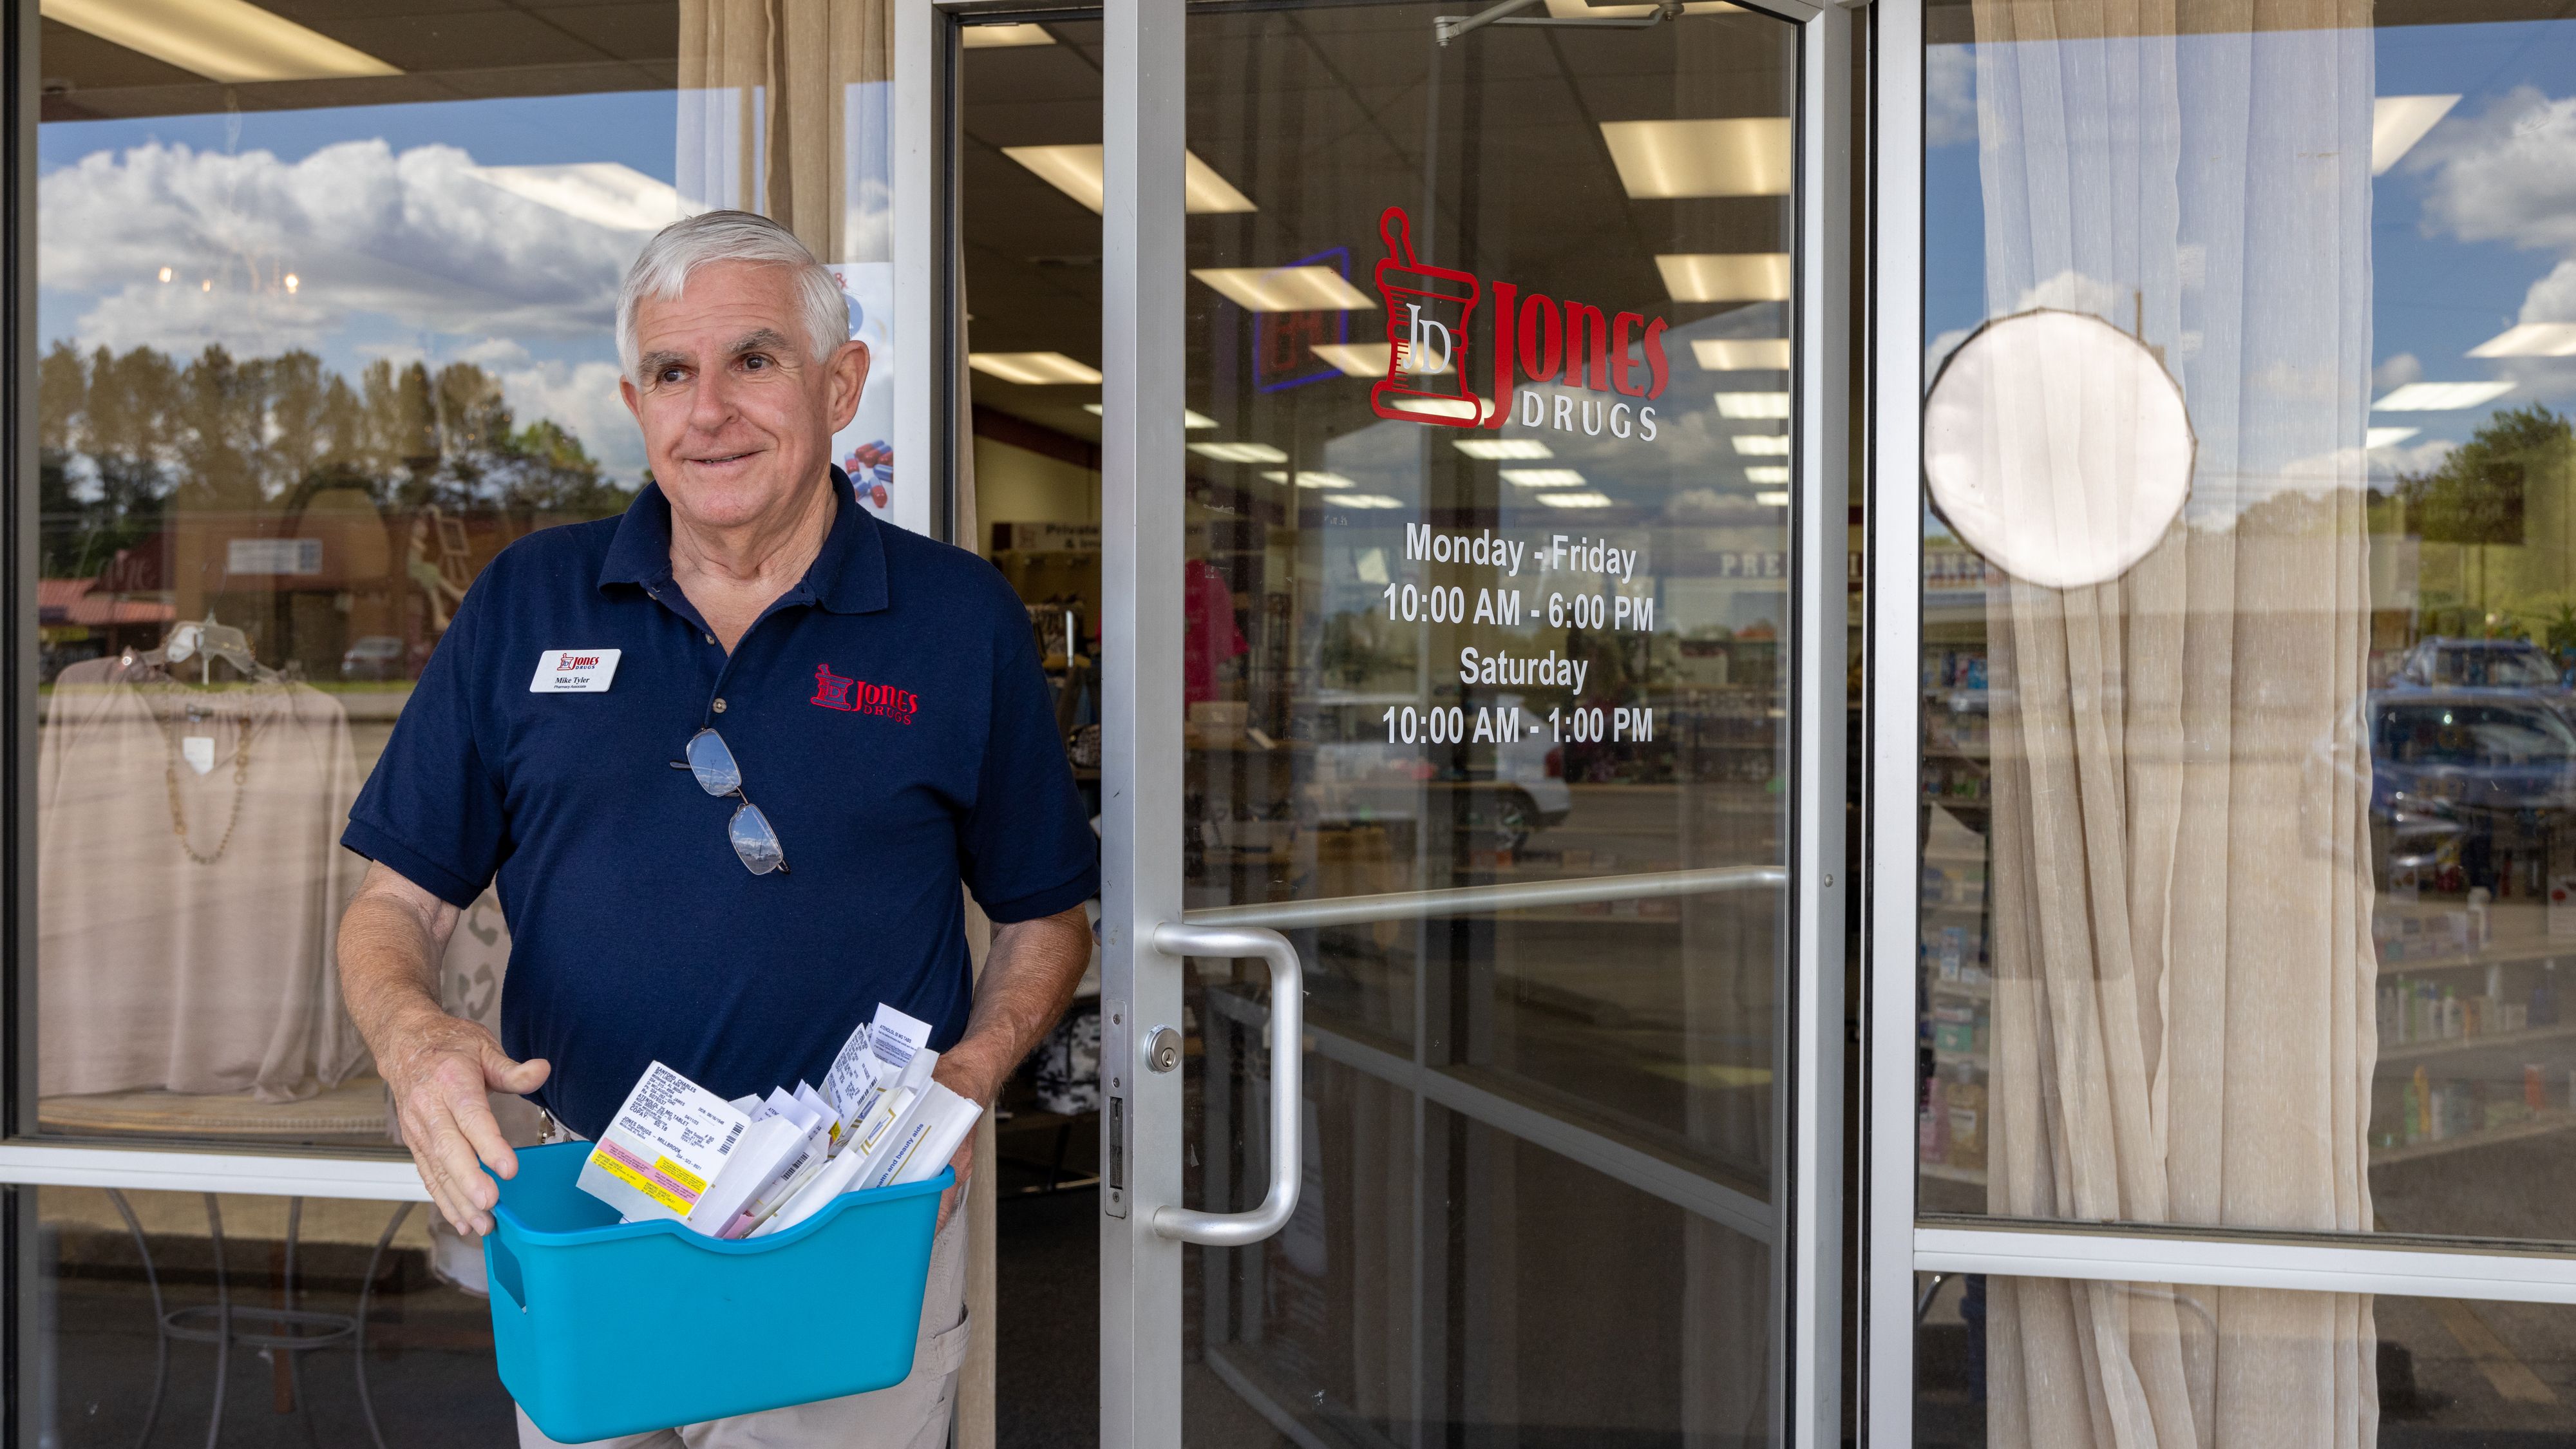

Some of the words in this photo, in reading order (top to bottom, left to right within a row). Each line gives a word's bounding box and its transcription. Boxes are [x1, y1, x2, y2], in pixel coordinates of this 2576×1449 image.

[1403, 303, 1451, 374] JD
[1521, 390, 1656, 441] DRUGS
[1406, 522, 1524, 577] Monday
[1553, 534, 1636, 584] Friday
[1383, 583, 1464, 623] 10:00
[1473, 589, 1520, 626] AM
[1548, 592, 1605, 630] 6:00
[1615, 596, 1653, 632] PM
[1460, 647, 1589, 696] Saturday
[864, 705, 911, 725] DRUGS
[1382, 705, 1464, 744] 10:00
[1472, 706, 1519, 743] AM
[1548, 707, 1604, 743] 1:00
[1614, 707, 1653, 743] PM
[878, 1024, 896, 1035] ATENOLOL
[676, 1079, 697, 1094] CHARLES
[629, 1105, 649, 1120] COPAY:
[652, 1120, 668, 1132] $5.18
[637, 1092, 660, 1109] ATENOLOL
[664, 1109, 674, 1117] MG
[672, 1114, 689, 1127] TABLET
[621, 1115, 638, 1127] JONES
[636, 1123, 652, 1136] DRUGS
[656, 1136, 681, 1154] MILLBROOK
[875, 1171, 889, 1189] ealth
[886, 1158, 898, 1173] and
[895, 1136, 914, 1160] beauty
[911, 1122, 924, 1138] aids
